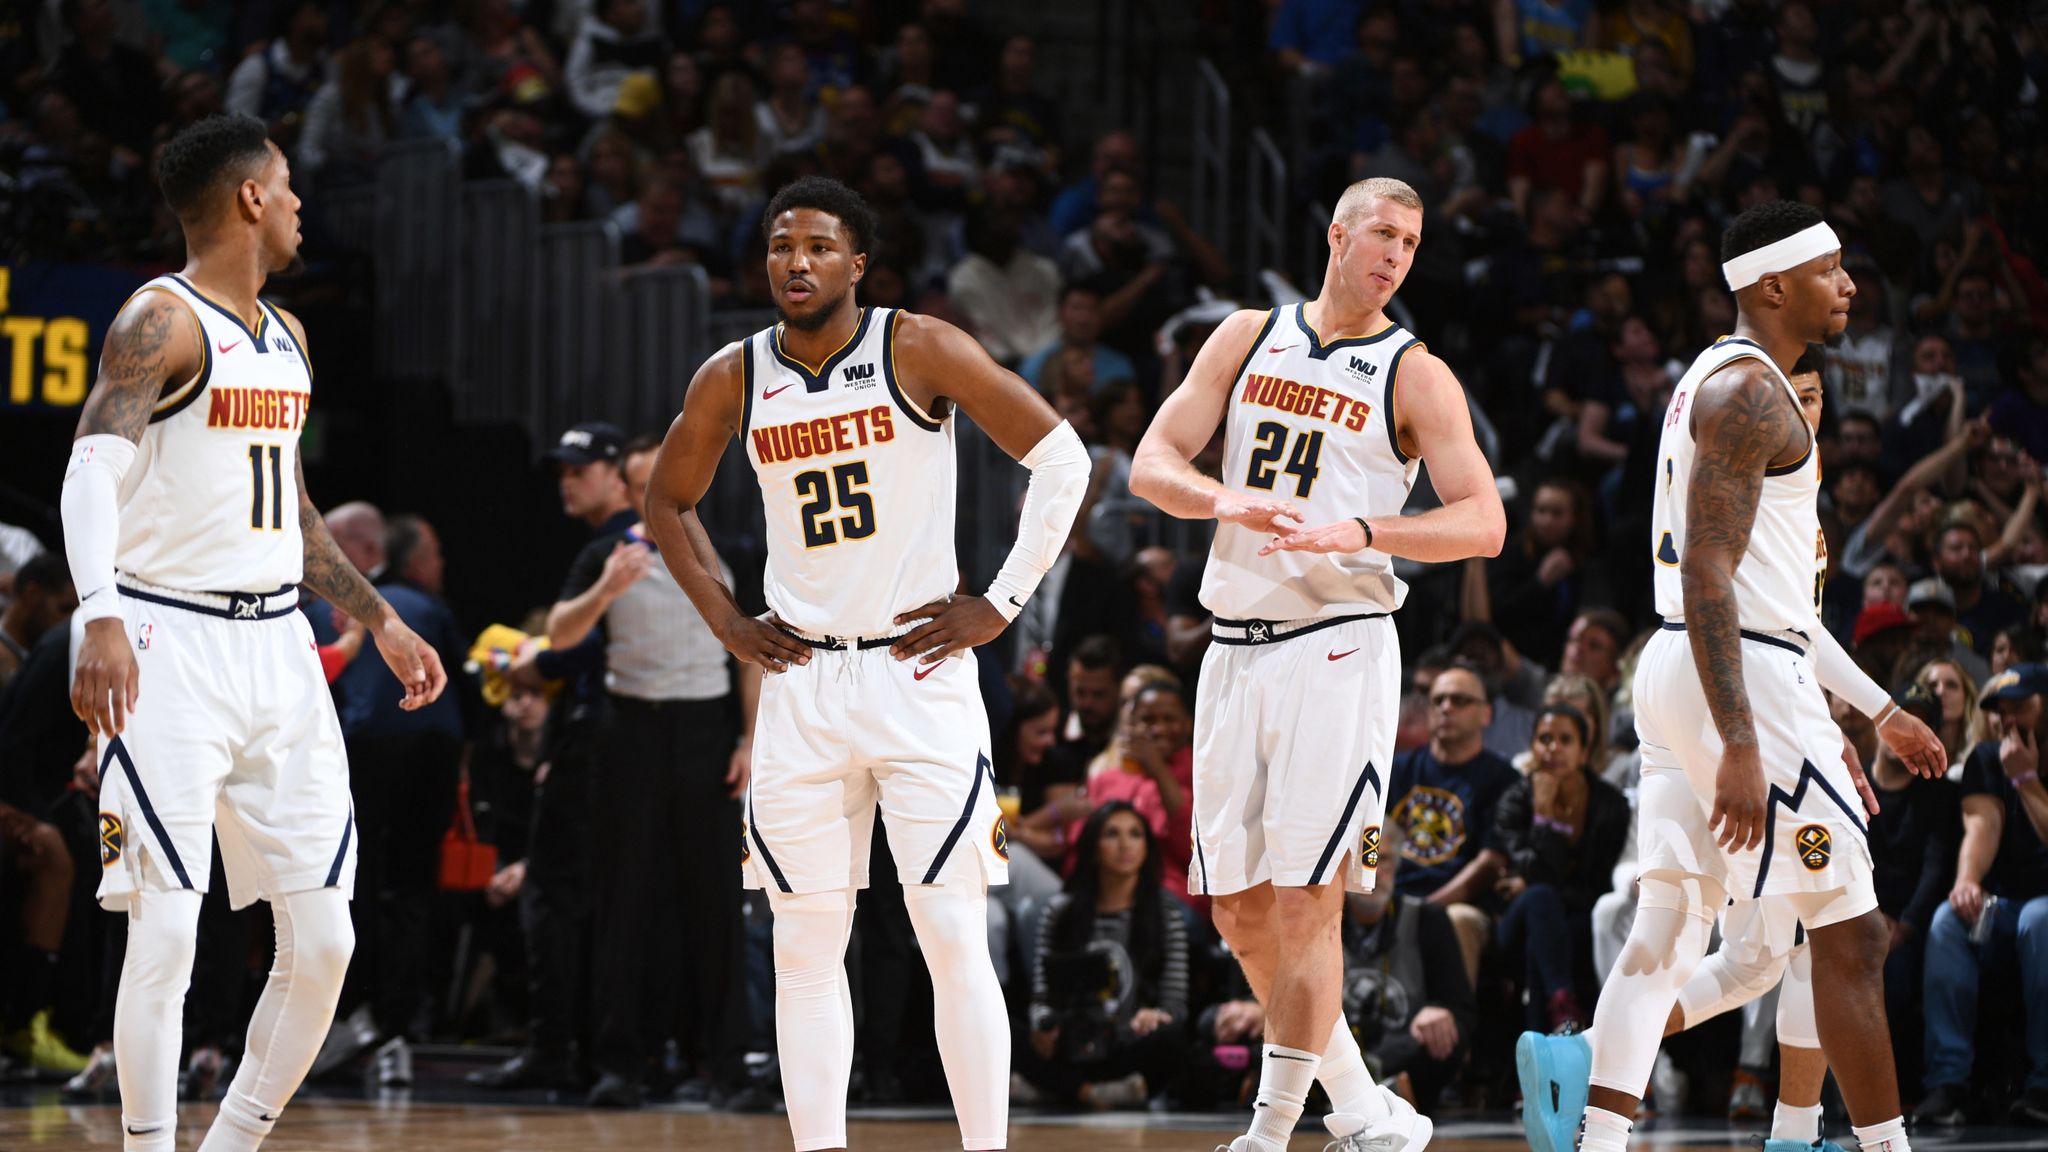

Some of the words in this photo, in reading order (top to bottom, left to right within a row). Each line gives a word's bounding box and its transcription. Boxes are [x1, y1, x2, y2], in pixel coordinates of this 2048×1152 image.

[843, 363, 875, 382] WU
[1344, 367, 1372, 382] WESTERN
[1349, 355, 1378, 376] WU
[844, 378, 876, 388] WESTERN
[854, 383, 877, 391] UNION
[1351, 374, 1371, 385] UNION
[1240, 373, 1372, 433] NUGGETS
[751, 405, 895, 465] NUGGETS
[1245, 420, 1326, 501] 24
[248, 443, 283, 532] 11
[793, 459, 877, 550] 25
